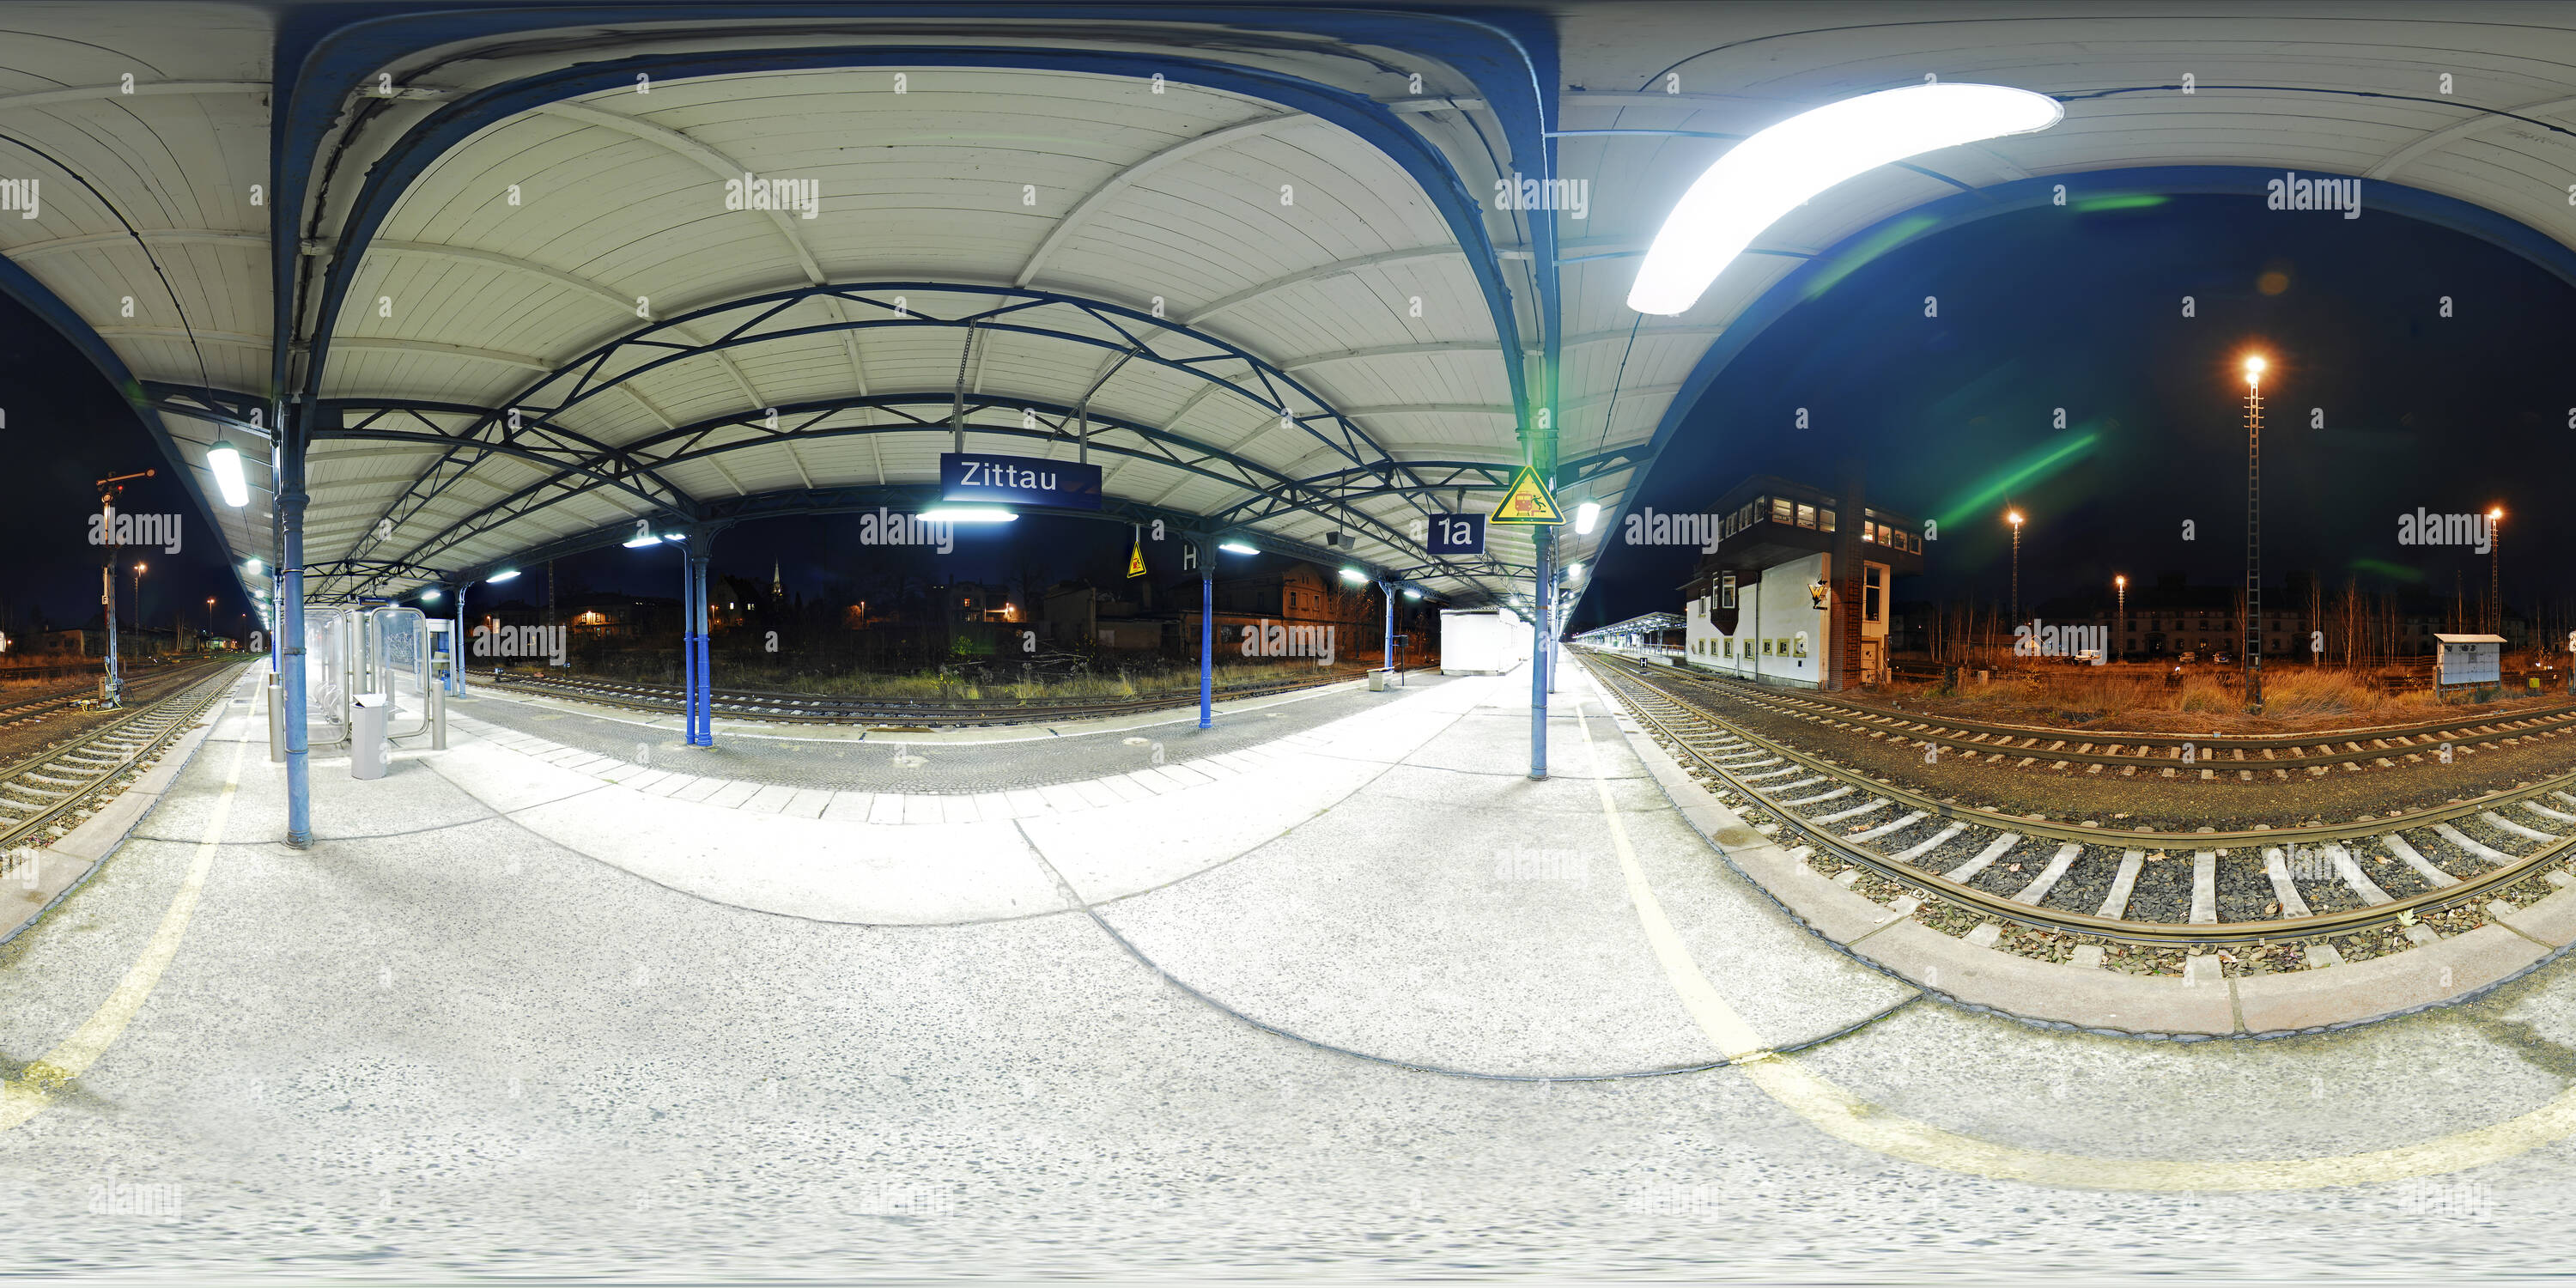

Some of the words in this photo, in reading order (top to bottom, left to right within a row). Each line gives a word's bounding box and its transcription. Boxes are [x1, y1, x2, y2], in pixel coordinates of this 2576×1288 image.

[961, 461, 1056, 490] Zittau
[1438, 516, 1473, 545] 1a
[1184, 544, 1197, 571] H
[1640, 658, 1648, 667] H
